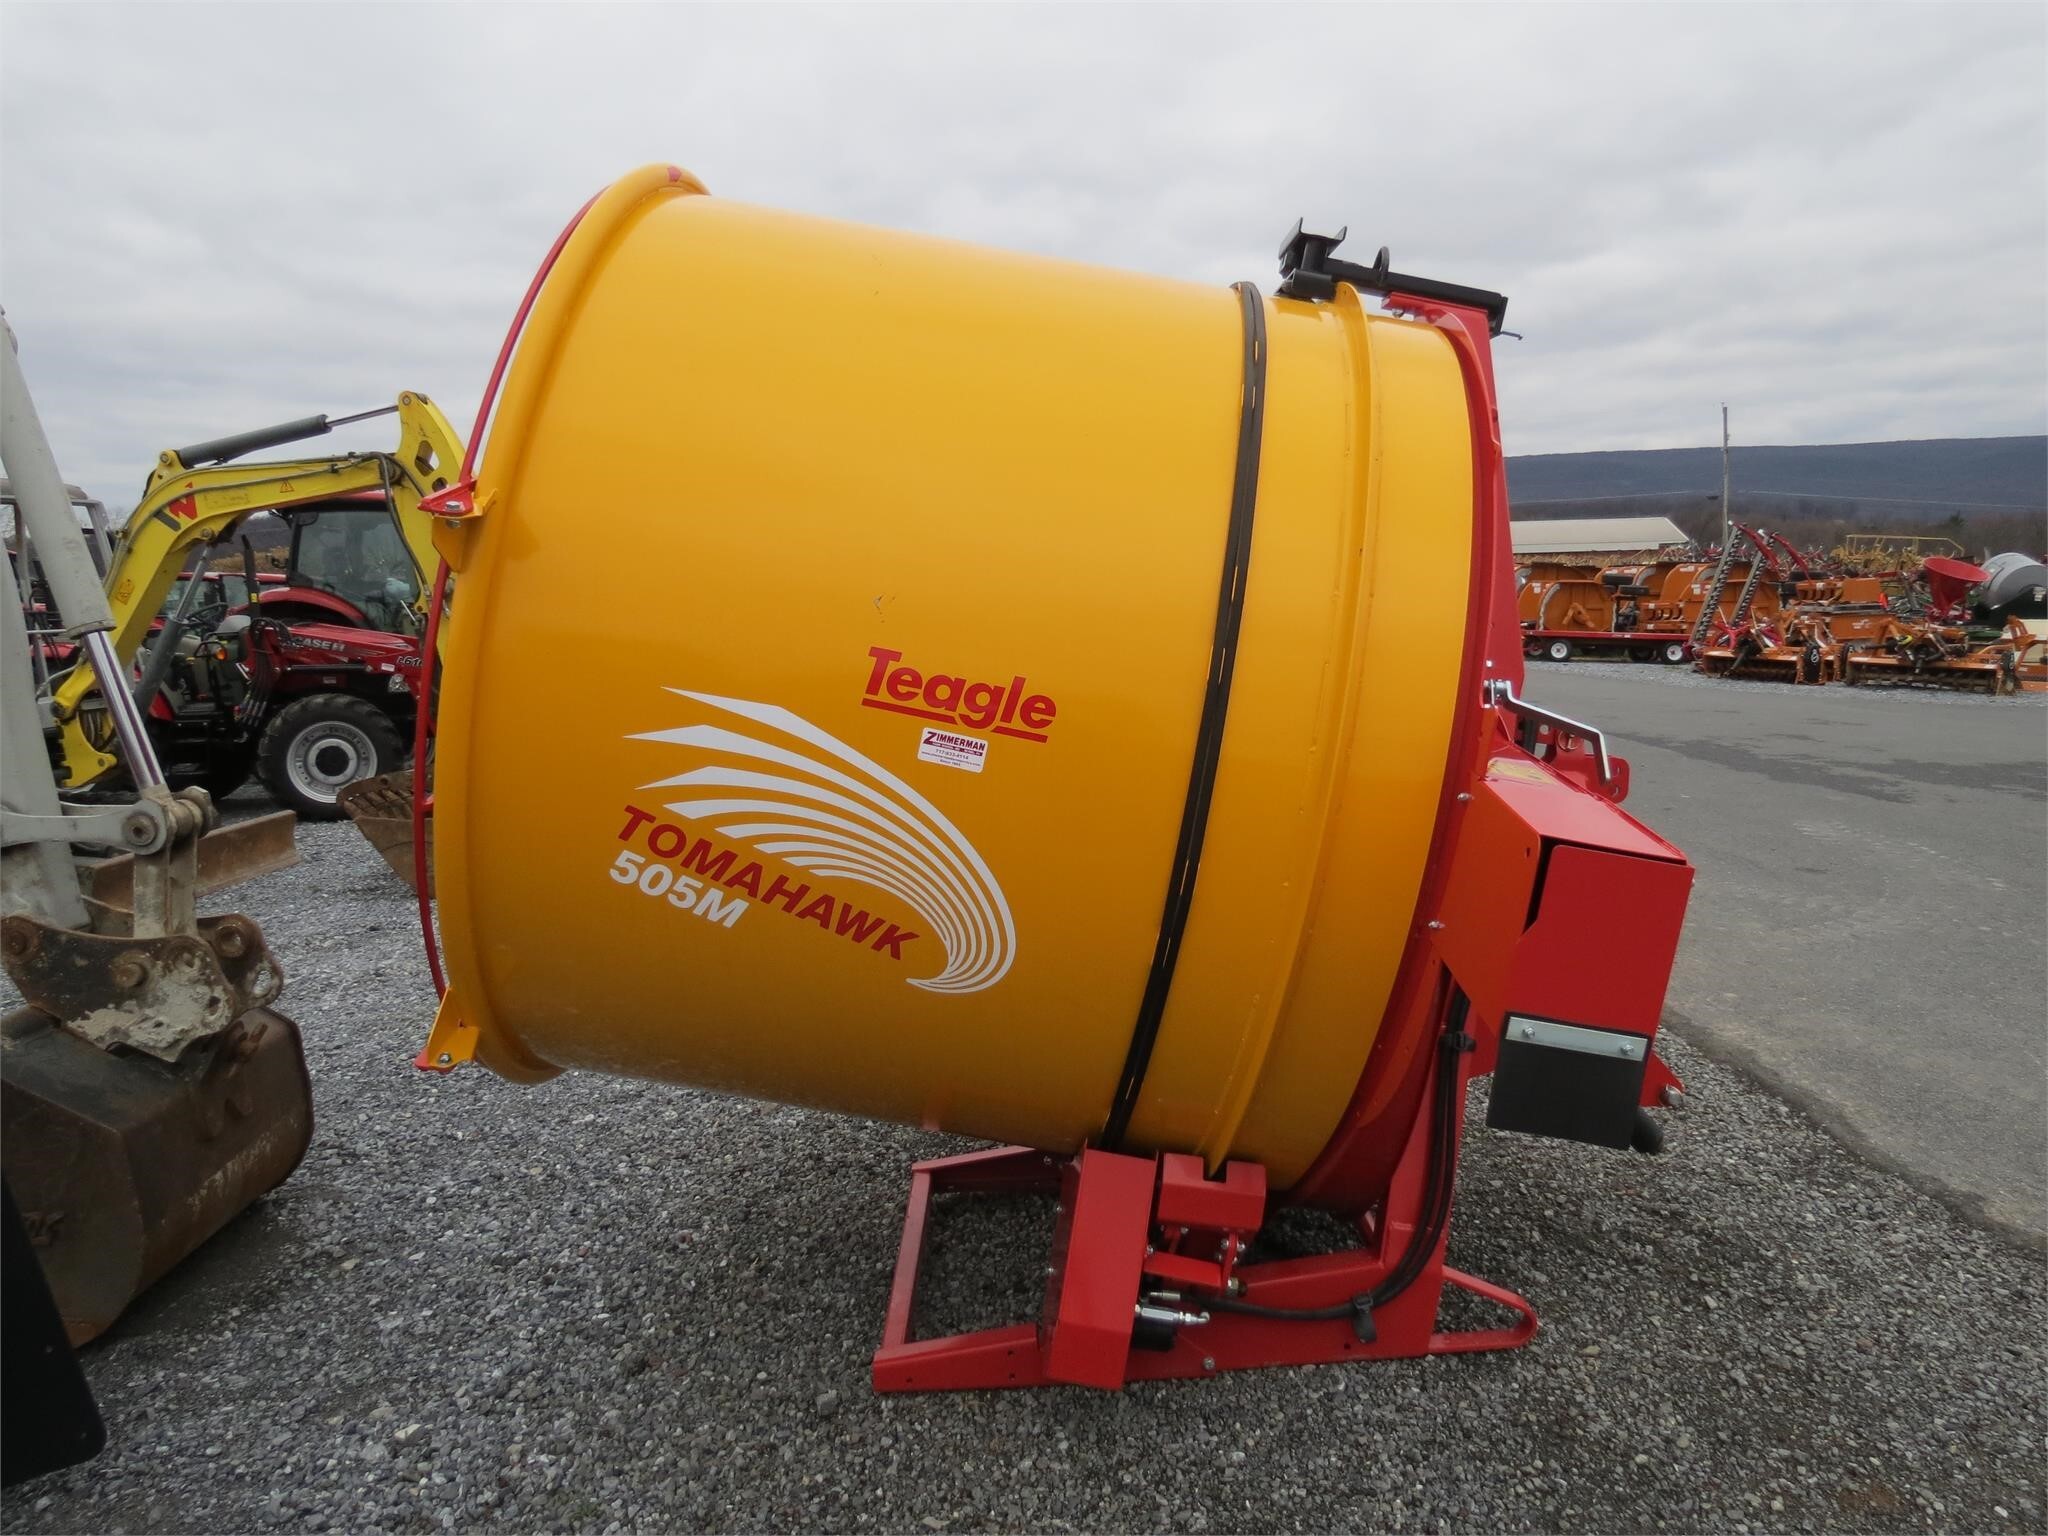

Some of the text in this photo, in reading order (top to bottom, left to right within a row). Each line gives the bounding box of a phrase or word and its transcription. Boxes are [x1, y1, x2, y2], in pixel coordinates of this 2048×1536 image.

[864, 646, 1058, 731] Teagle
[923, 731, 986, 752] ZIMMERMAN
[609, 849, 749, 929] 505M
[617, 804, 921, 962] TOMAHAWK
